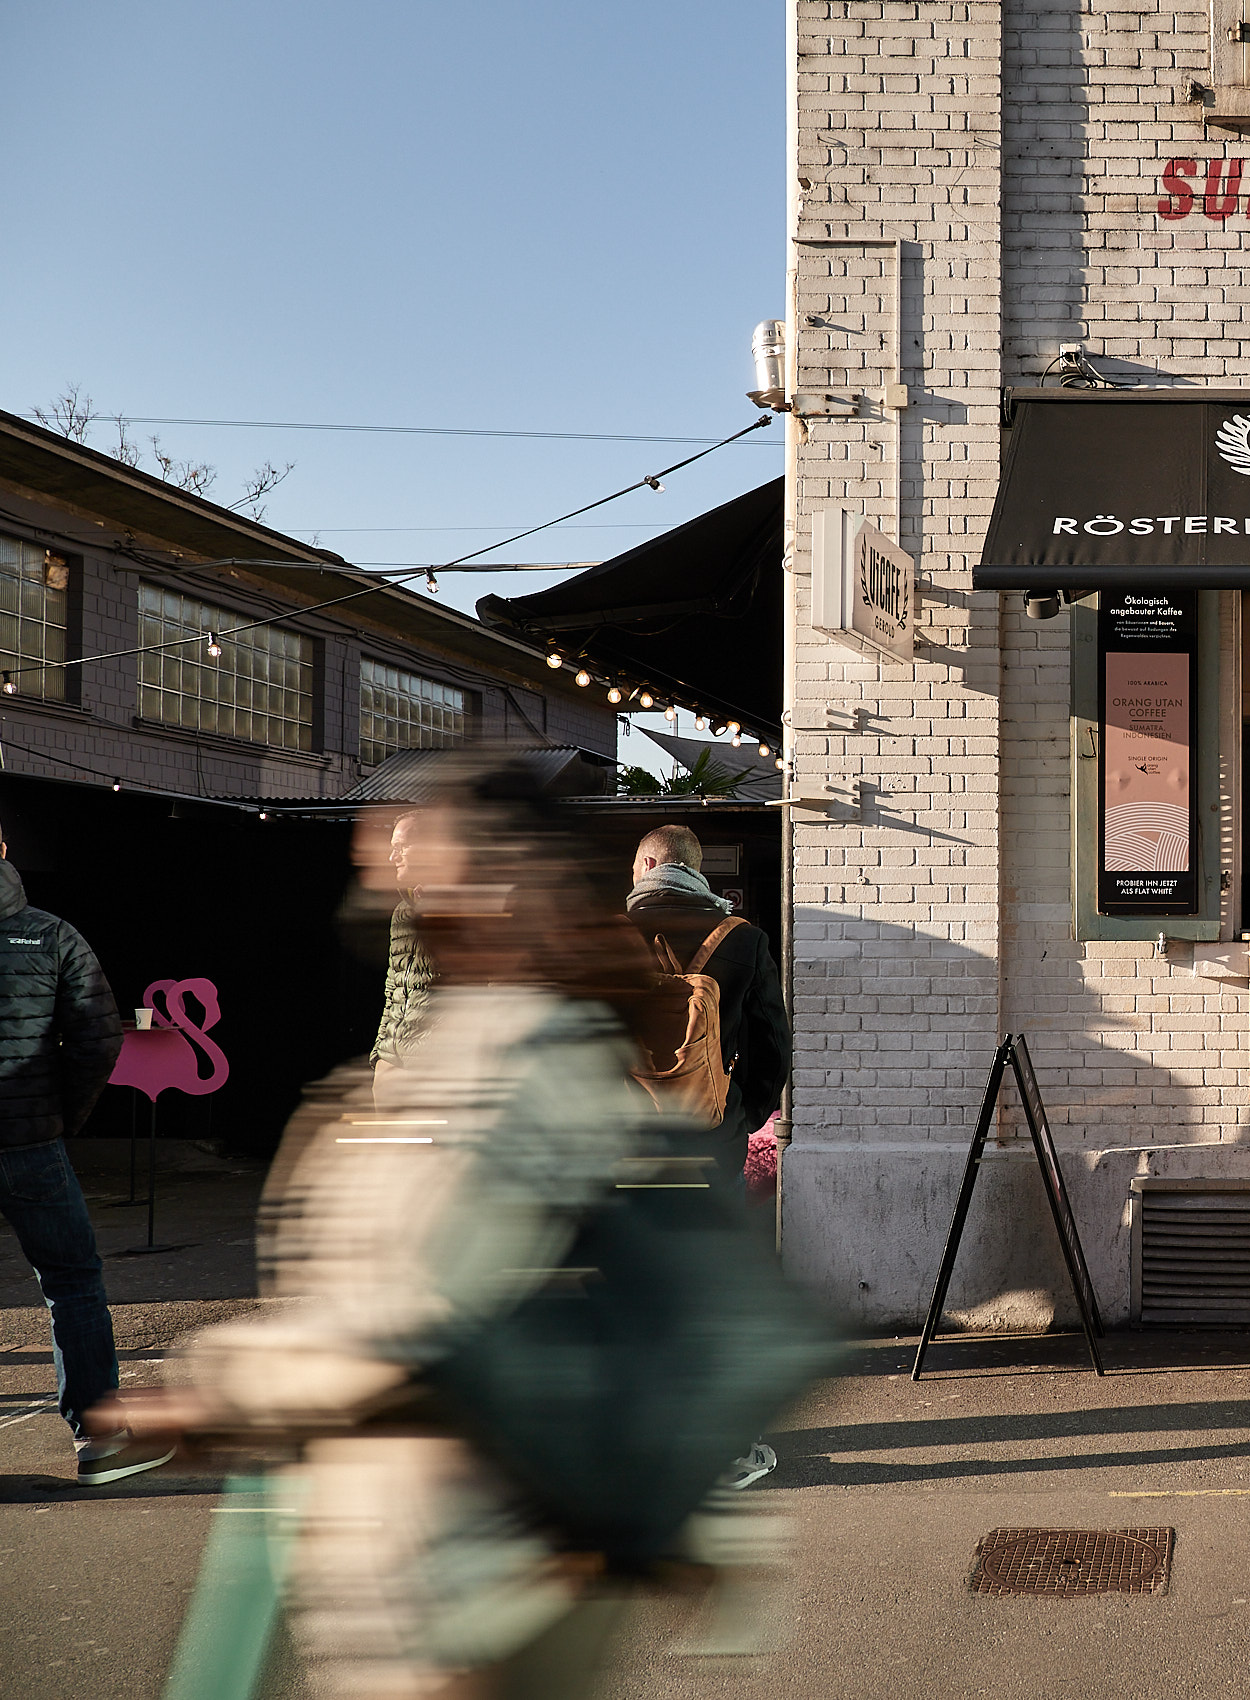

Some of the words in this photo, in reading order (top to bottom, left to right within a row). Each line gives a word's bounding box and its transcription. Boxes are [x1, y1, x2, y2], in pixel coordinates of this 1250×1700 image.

[1124, 594, 1169, 606] Ökologisch
[1110, 607, 1155, 617] angebauter
[1157, 607, 1183, 616] Kaffee
[874, 615, 895, 639] GEROLD
[1112, 698, 1152, 707] ORANG
[1155, 698, 1183, 707] UTAN
[1129, 708, 1167, 717] COFFEE
[1129, 724, 1166, 732] SUMATRA,
[1116, 879, 1144, 887] PROBIER
[1145, 879, 1158, 887] IHN
[1159, 879, 1178, 887] JETZT
